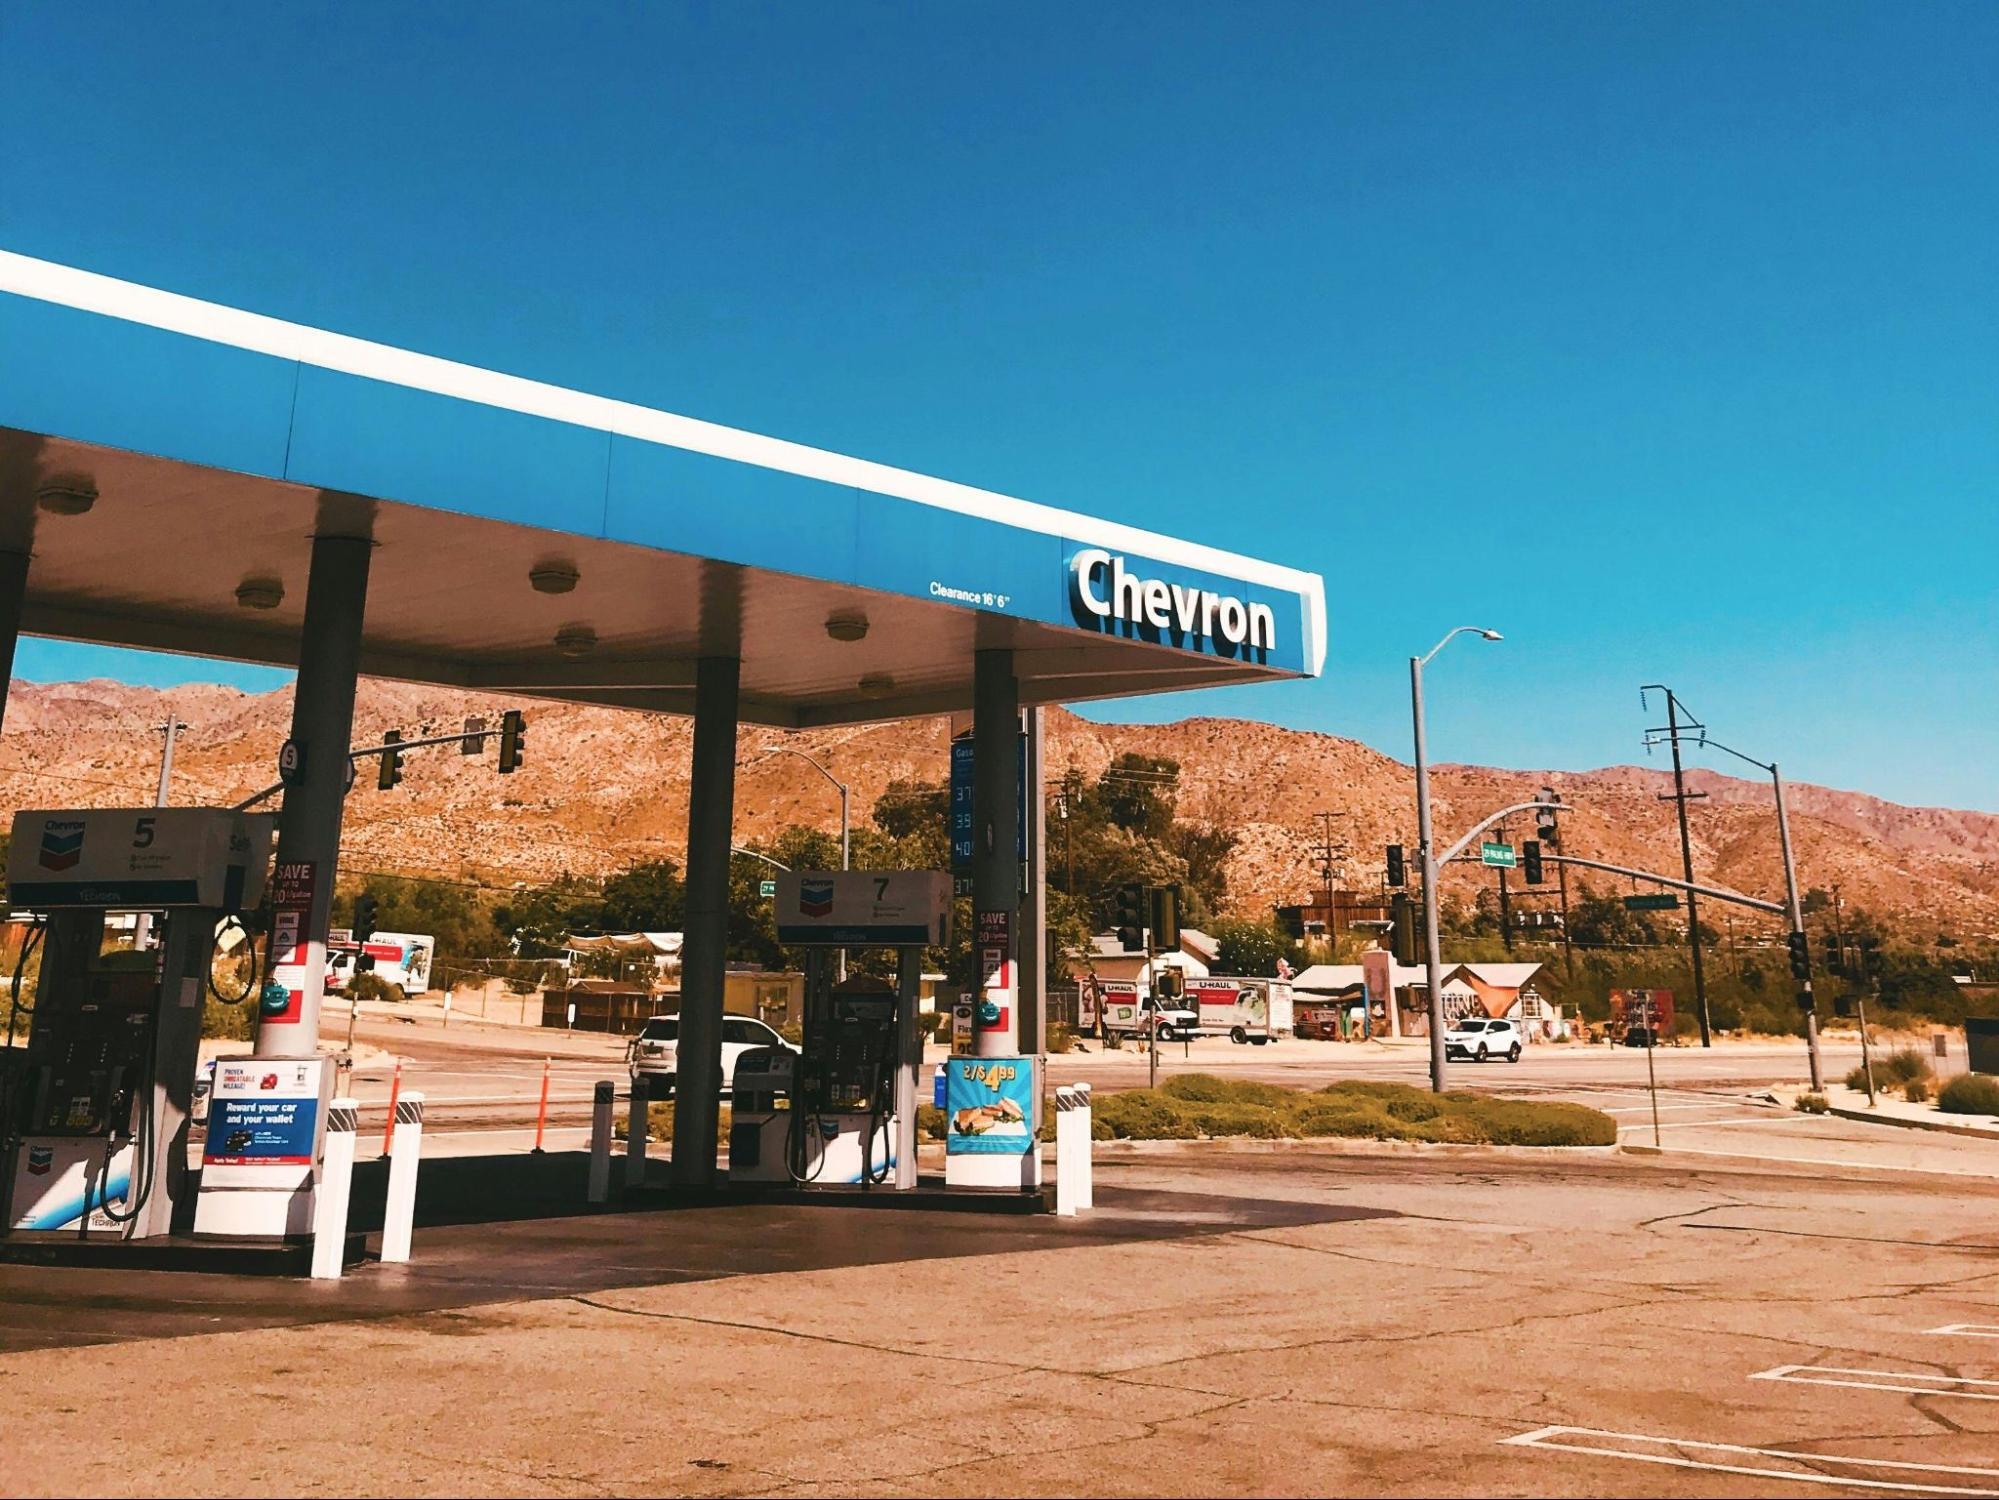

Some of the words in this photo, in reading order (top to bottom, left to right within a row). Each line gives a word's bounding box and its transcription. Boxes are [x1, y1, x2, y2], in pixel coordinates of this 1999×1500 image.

[930, 581, 981, 604] Clearance
[1070, 549, 1275, 649] Chevron
[286, 749, 294, 765] 5
[956, 786, 974, 801] 37
[45, 820, 86, 831] Chevron
[956, 814, 974, 829] 39
[132, 817, 156, 848] 5
[955, 841, 974, 856] 40
[277, 864, 311, 880] SAVE
[801, 878, 834, 887] Chevron
[873, 878, 890, 901] 7
[980, 912, 1006, 925] SAVE
[226, 1102, 257, 1113] Reward
[258, 1104, 279, 1114] your
[281, 1103, 298, 1112] car
[226, 1114, 242, 1124] and
[243, 1115, 264, 1125] your
[265, 1114, 294, 1124] wallet
